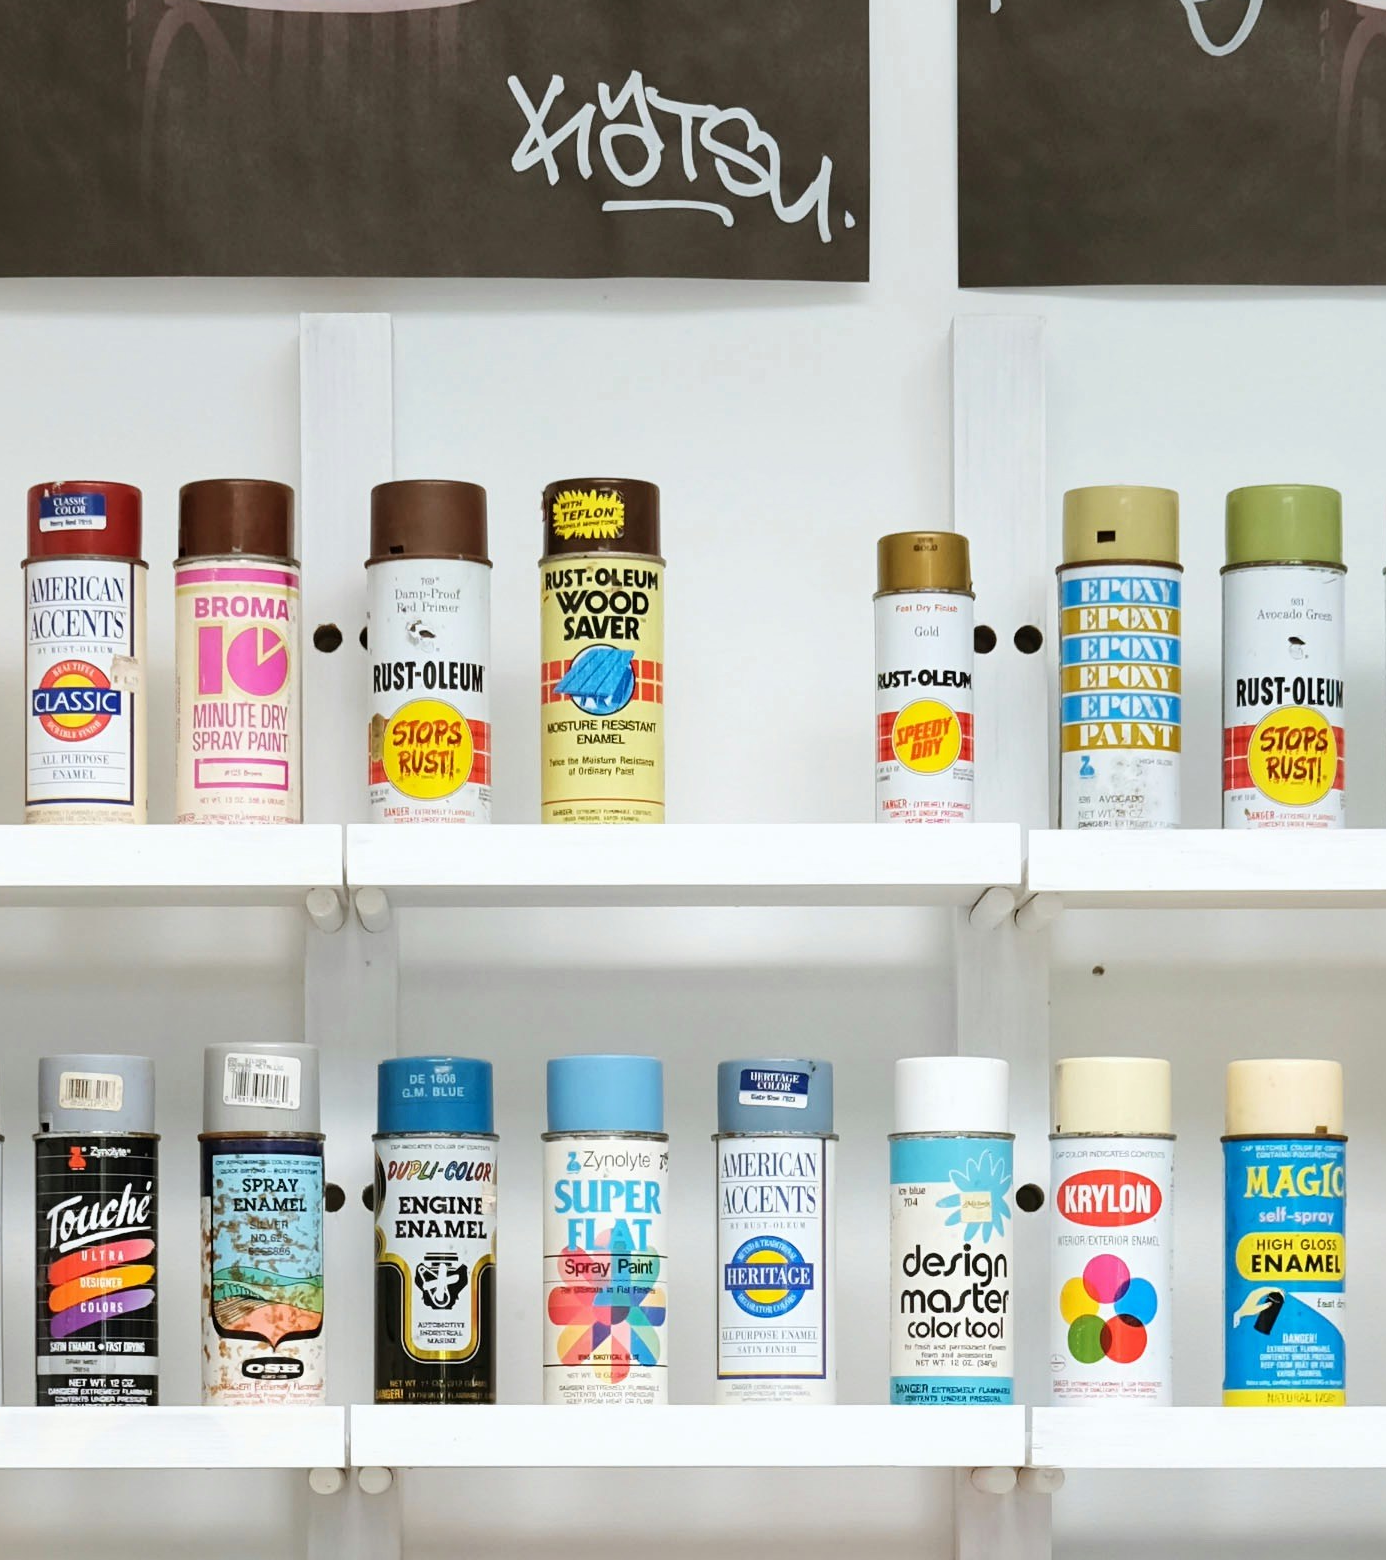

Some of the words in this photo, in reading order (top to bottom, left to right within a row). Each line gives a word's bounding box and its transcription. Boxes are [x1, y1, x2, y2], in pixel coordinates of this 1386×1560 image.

[55, 506, 86, 515] COLOR
[29, 577, 123, 604] AMERICAN
[545, 570, 658, 591] RUST-OLEUM
[1080, 579, 1171, 603] EPOXY
[194, 597, 289, 620] BROMA
[558, 593, 649, 614] WOOD
[29, 610, 125, 639] ACCENTS
[1258, 610, 1301, 621] Avocado
[1303, 610, 1332, 621] Green
[563, 617, 640, 641] SAVER
[914, 626, 938, 638] Gold
[35, 691, 117, 713] CLASSIC
[193, 704, 256, 730] MINUTE
[261, 708, 288, 729] DRY
[548, 721, 597, 734] MOISTURE
[600, 720, 657, 732] RESISTANT
[577, 735, 624, 745] ENAMEL
[897, 717, 953, 743] SPEEDY
[1079, 725, 1174, 748] PAINT
[40, 754, 59, 764] ALL
[63, 753, 109, 764] PURPOSE
[911, 739, 943, 759] DRY
[51, 770, 96, 781] ENAMEL
[433, 1086, 465, 1096] BLUE
[388, 1159, 492, 1183] DUPLI-COLOR
[398, 1195, 483, 1217] ENGINE
[555, 1180, 660, 1215] SUPER
[1063, 1183, 1151, 1212] KRYLON
[47, 1182, 152, 1245] Touché
[1259, 1208, 1334, 1225] self-spray
[568, 1218, 651, 1252] FLAT
[565, 1258, 610, 1278] Spray
[618, 1257, 652, 1275] Paint
[902, 1244, 1007, 1284] design
[728, 1266, 810, 1287] HERITAGE
